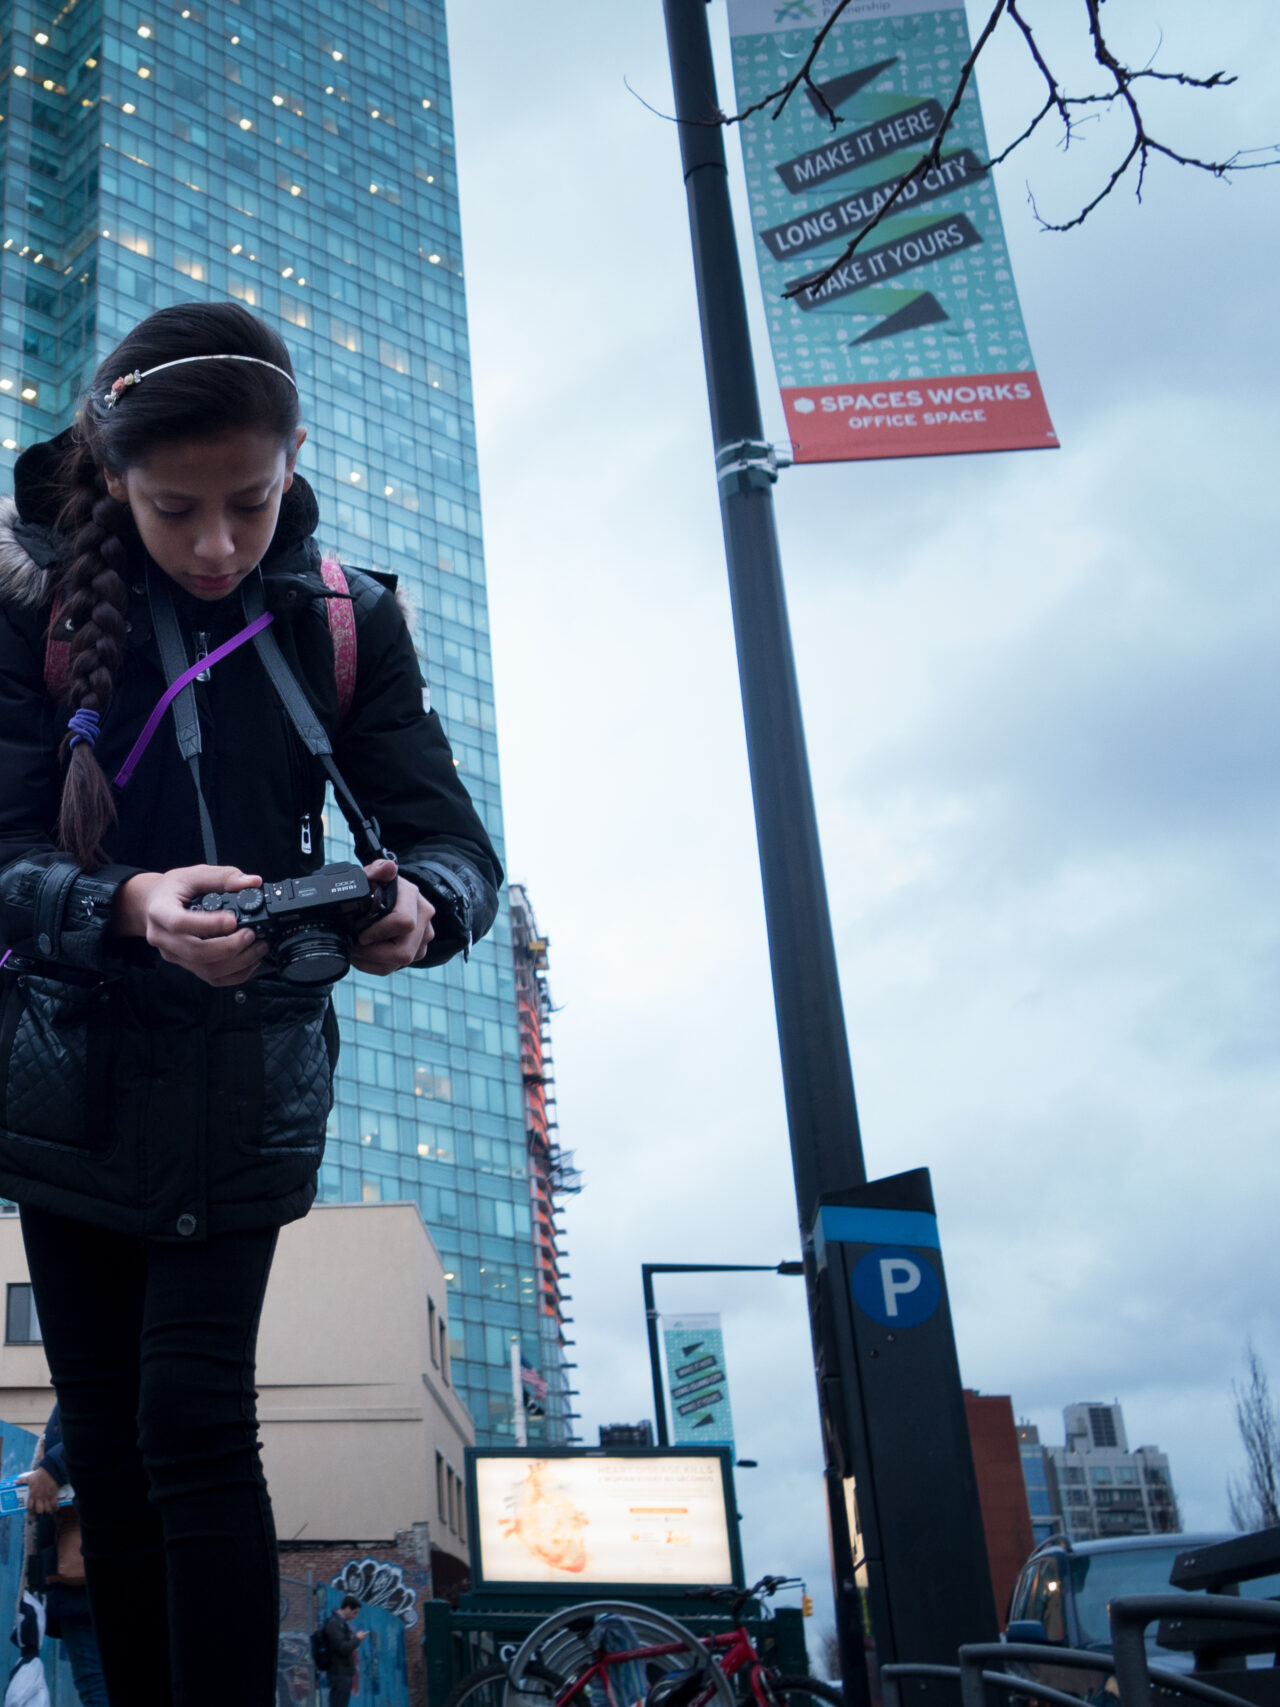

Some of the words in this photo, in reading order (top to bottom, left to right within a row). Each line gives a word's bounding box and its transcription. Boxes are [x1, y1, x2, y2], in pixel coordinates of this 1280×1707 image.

[793, 142, 855, 183] MAKE
[857, 132, 875, 156] IT
[878, 108, 935, 147] HERE
[775, 212, 837, 251] LONG
[838, 178, 919, 225] ISLAND
[922, 156, 968, 190] CITY
[868, 253, 886, 275] IT
[889, 224, 964, 267] YOURS
[821, 391, 924, 413] SPACES
[928, 383, 1032, 406] WORKS
[848, 411, 917, 430] OFFICE
[923, 409, 987, 426] SPACE
[880, 1258, 922, 1317] P
